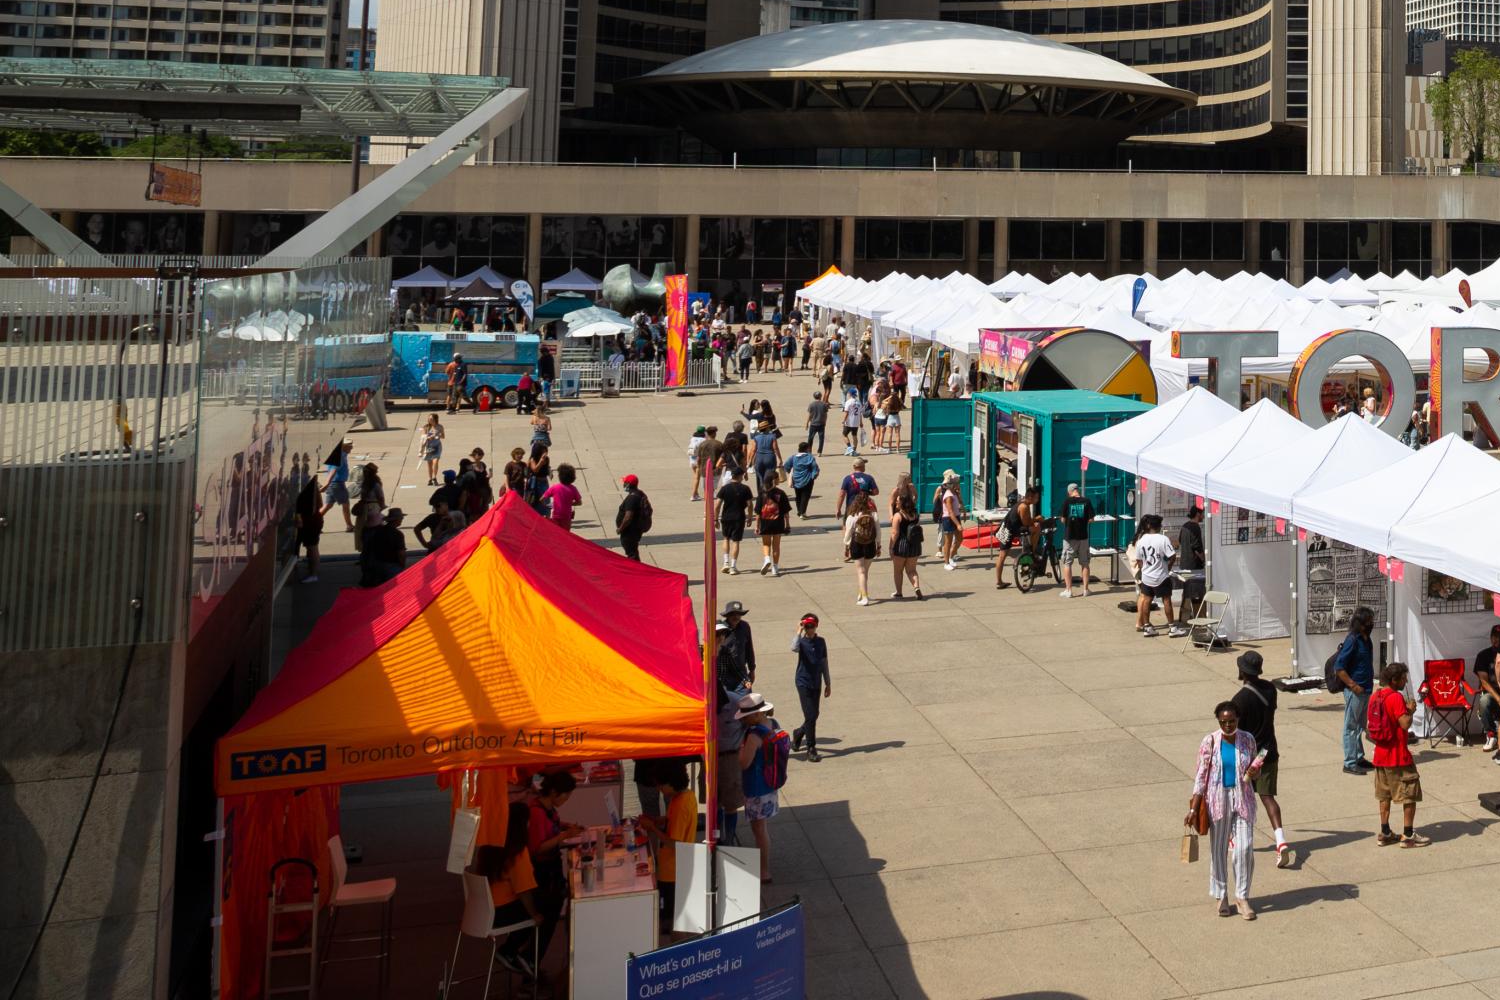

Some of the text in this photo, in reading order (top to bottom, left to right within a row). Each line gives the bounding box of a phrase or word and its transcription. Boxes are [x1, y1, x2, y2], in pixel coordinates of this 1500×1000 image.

[336, 743, 415, 765] Toronto
[422, 729, 505, 755] Outdoor
[513, 728, 544, 748] Art
[551, 726, 587, 745] Fair
[756, 923, 782, 939] Art Tours
[639, 947, 721, 980] What's on here
[639, 955, 742, 999] Que se passe-t-il ici
